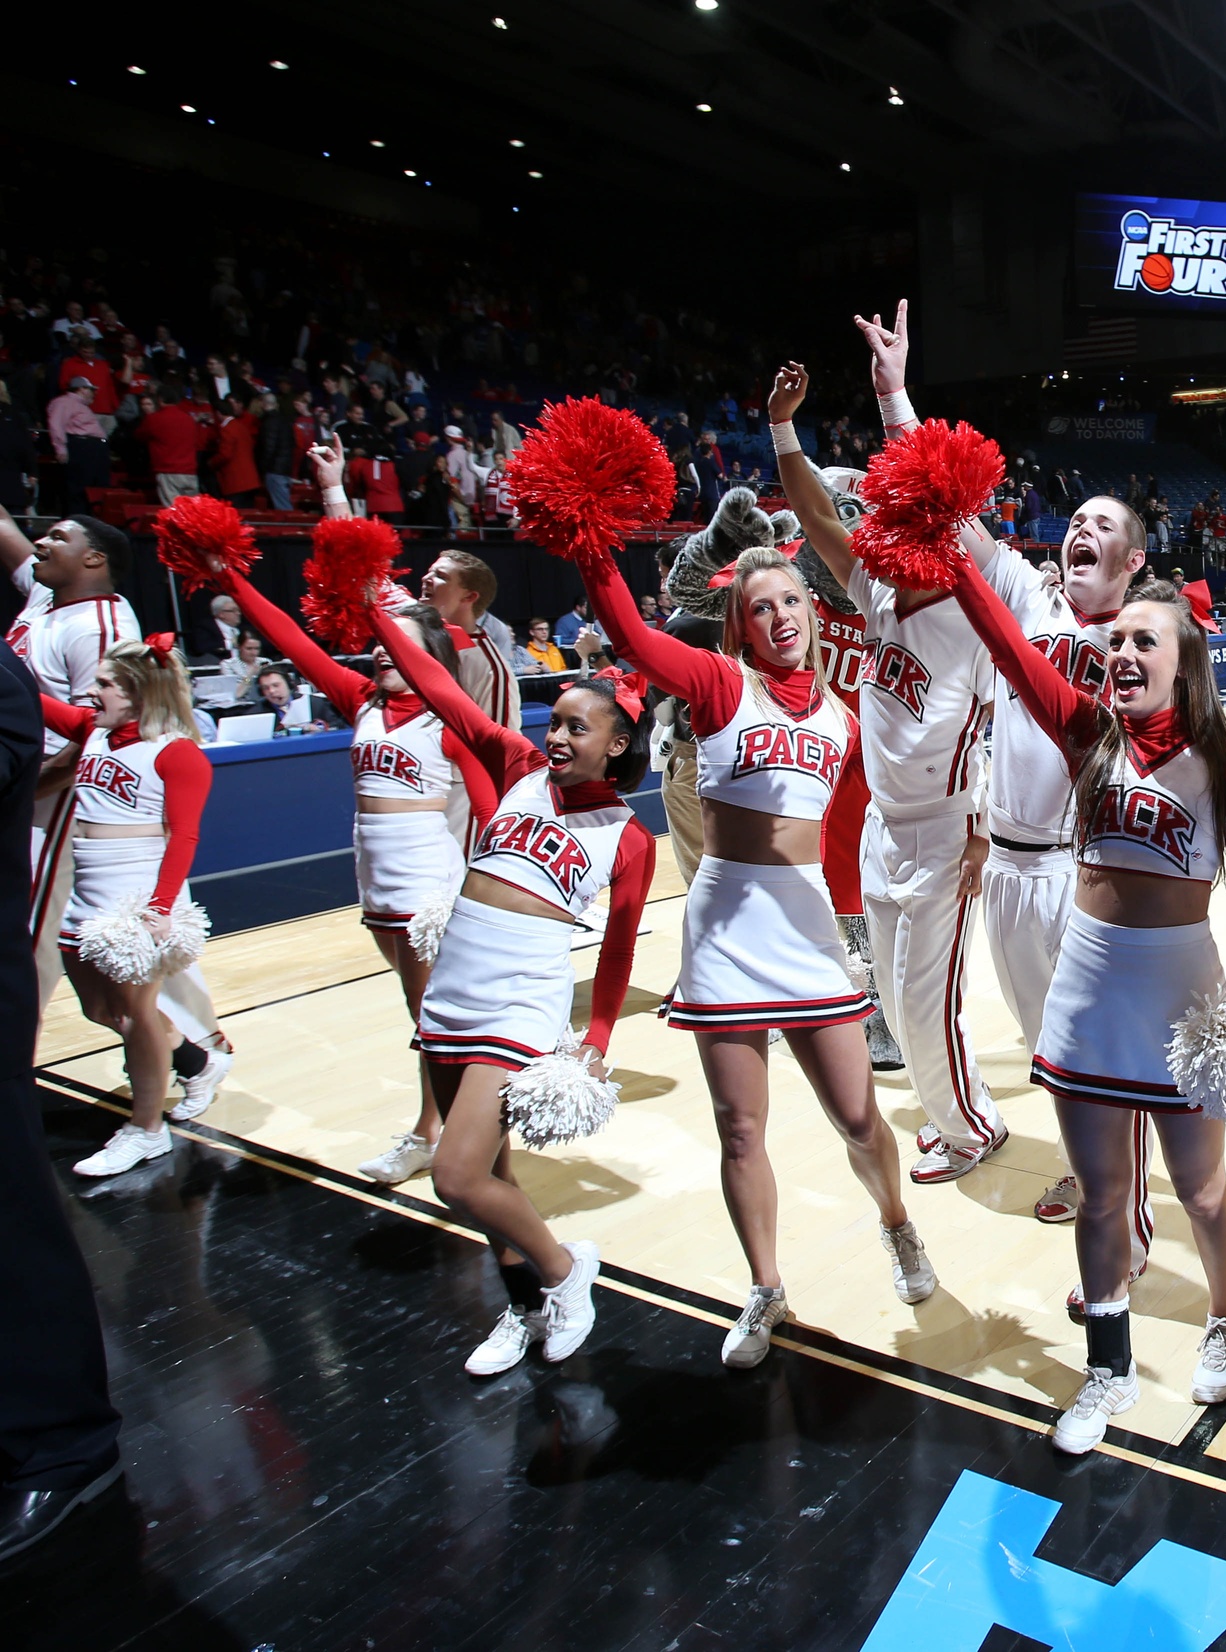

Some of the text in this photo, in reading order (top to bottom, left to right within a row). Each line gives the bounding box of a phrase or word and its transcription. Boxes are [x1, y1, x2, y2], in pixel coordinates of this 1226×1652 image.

[1074, 418, 1145, 430] WELCOME
[1076, 430, 1145, 440] TO DAYTON
[830, 621, 866, 645] STA
[1208, 648, 1221, 664] N'S
[350, 740, 424, 794] PACK
[732, 723, 842, 797] PACK
[1078, 784, 1196, 876] ACK
[472, 812, 592, 906] PACK
